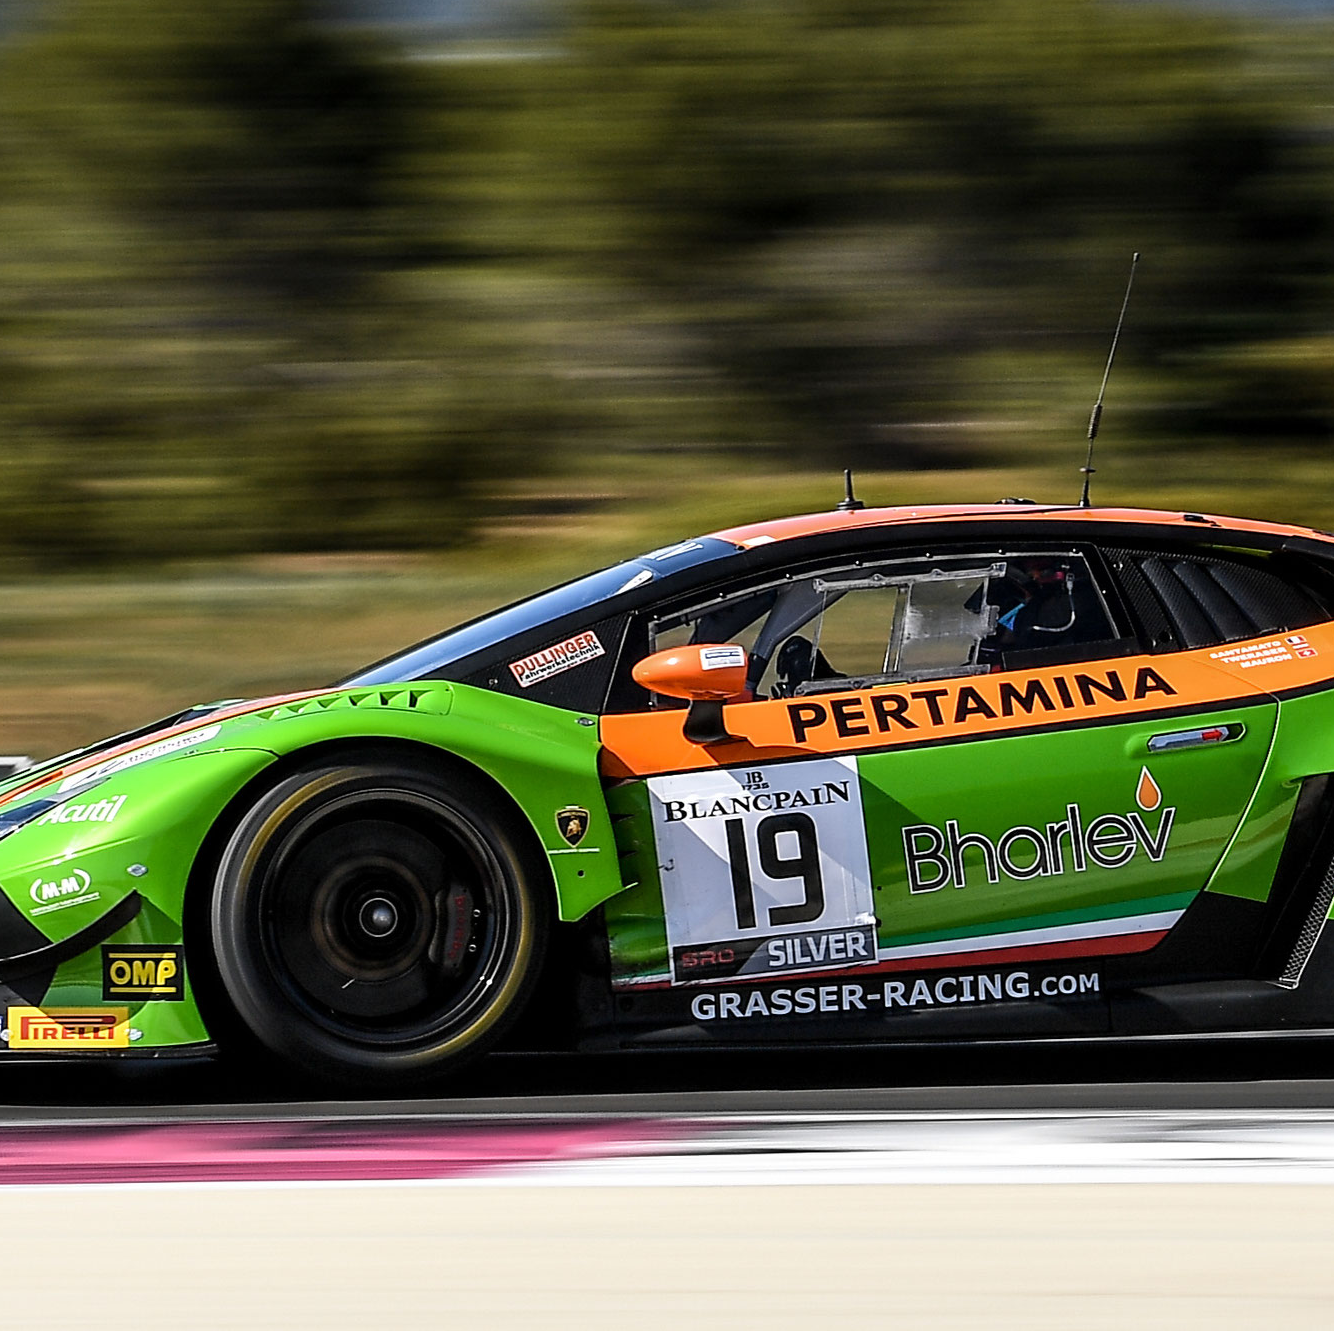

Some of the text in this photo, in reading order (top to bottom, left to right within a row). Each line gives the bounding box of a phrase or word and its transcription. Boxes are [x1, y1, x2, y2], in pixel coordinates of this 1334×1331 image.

[513, 634, 597, 677] DULLINGER
[786, 666, 1178, 744] PERTAMINA
[37, 795, 127, 826] Acutil
[662, 780, 850, 822] BLANCPAIN
[901, 803, 1176, 895] Bharlev
[724, 812, 825, 930] 19
[768, 931, 869, 967] SILVER
[109, 960, 177, 985] OMP
[19, 1015, 118, 1040] PIRELLI
